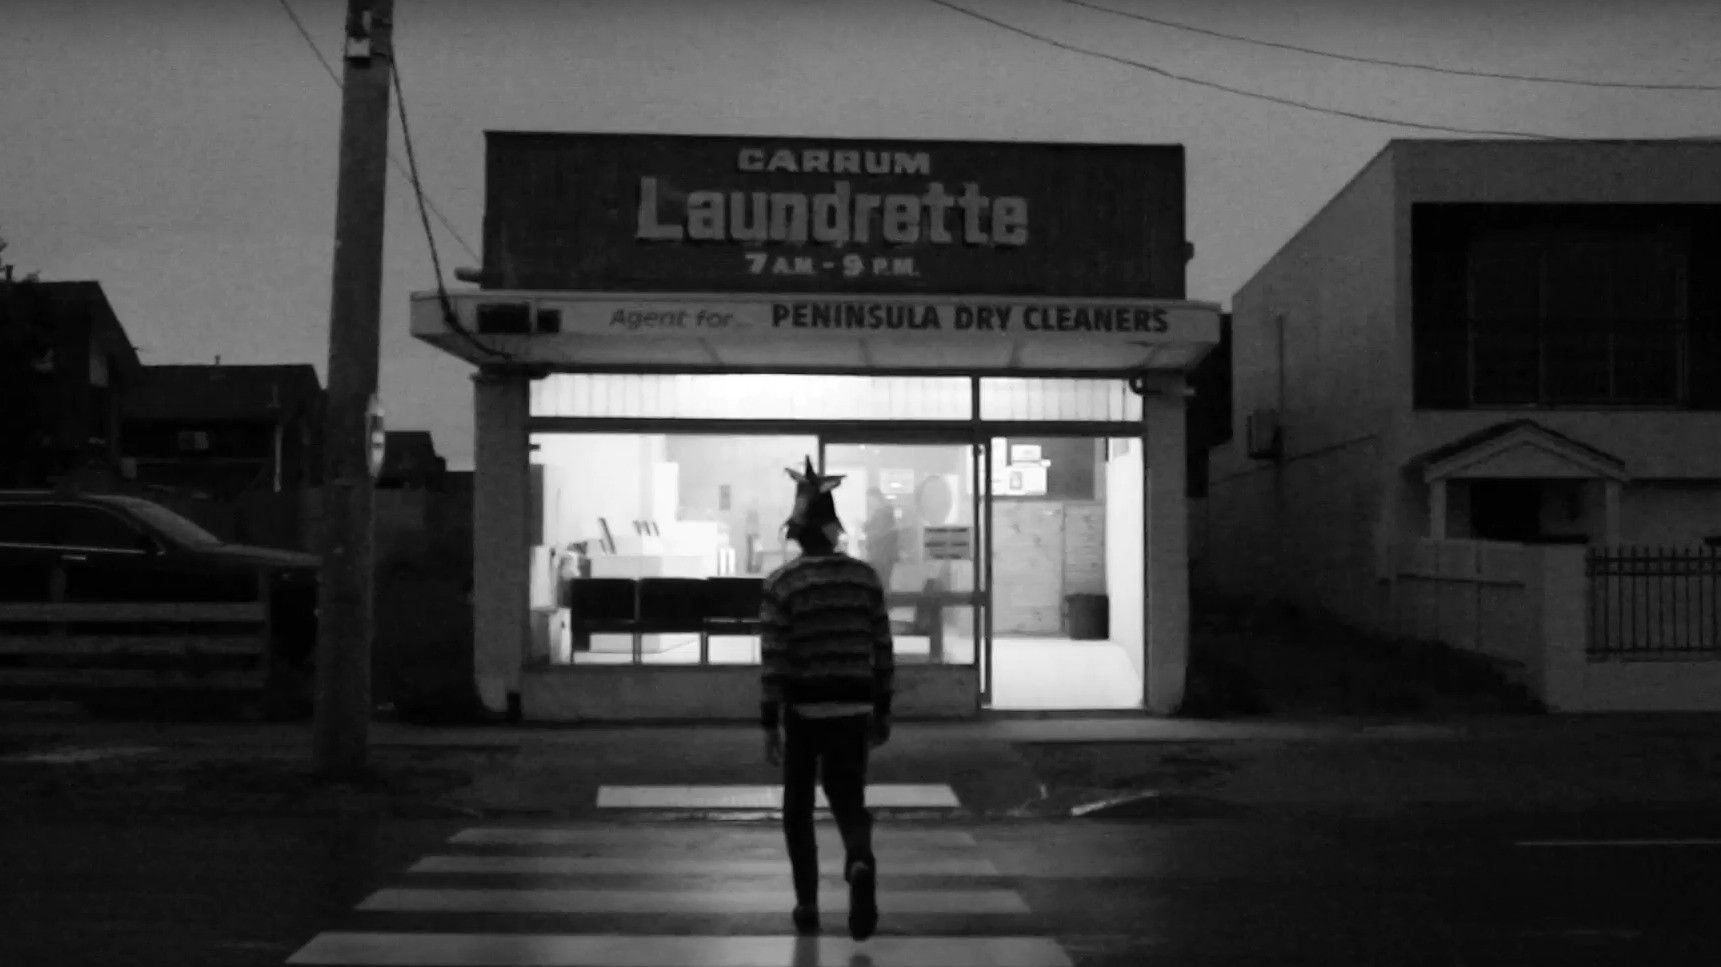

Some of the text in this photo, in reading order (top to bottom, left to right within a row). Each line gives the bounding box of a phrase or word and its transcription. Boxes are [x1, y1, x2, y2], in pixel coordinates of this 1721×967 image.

[738, 148, 930, 174] CARRUM
[637, 177, 1027, 246] Laundrette
[744, 252, 767, 273] 7
[842, 253, 864, 277] 9
[609, 308, 688, 328] Agent
[772, 302, 941, 329] PENINSULA
[953, 304, 1013, 330] DRY
[1023, 305, 1169, 333] CLEANERS
